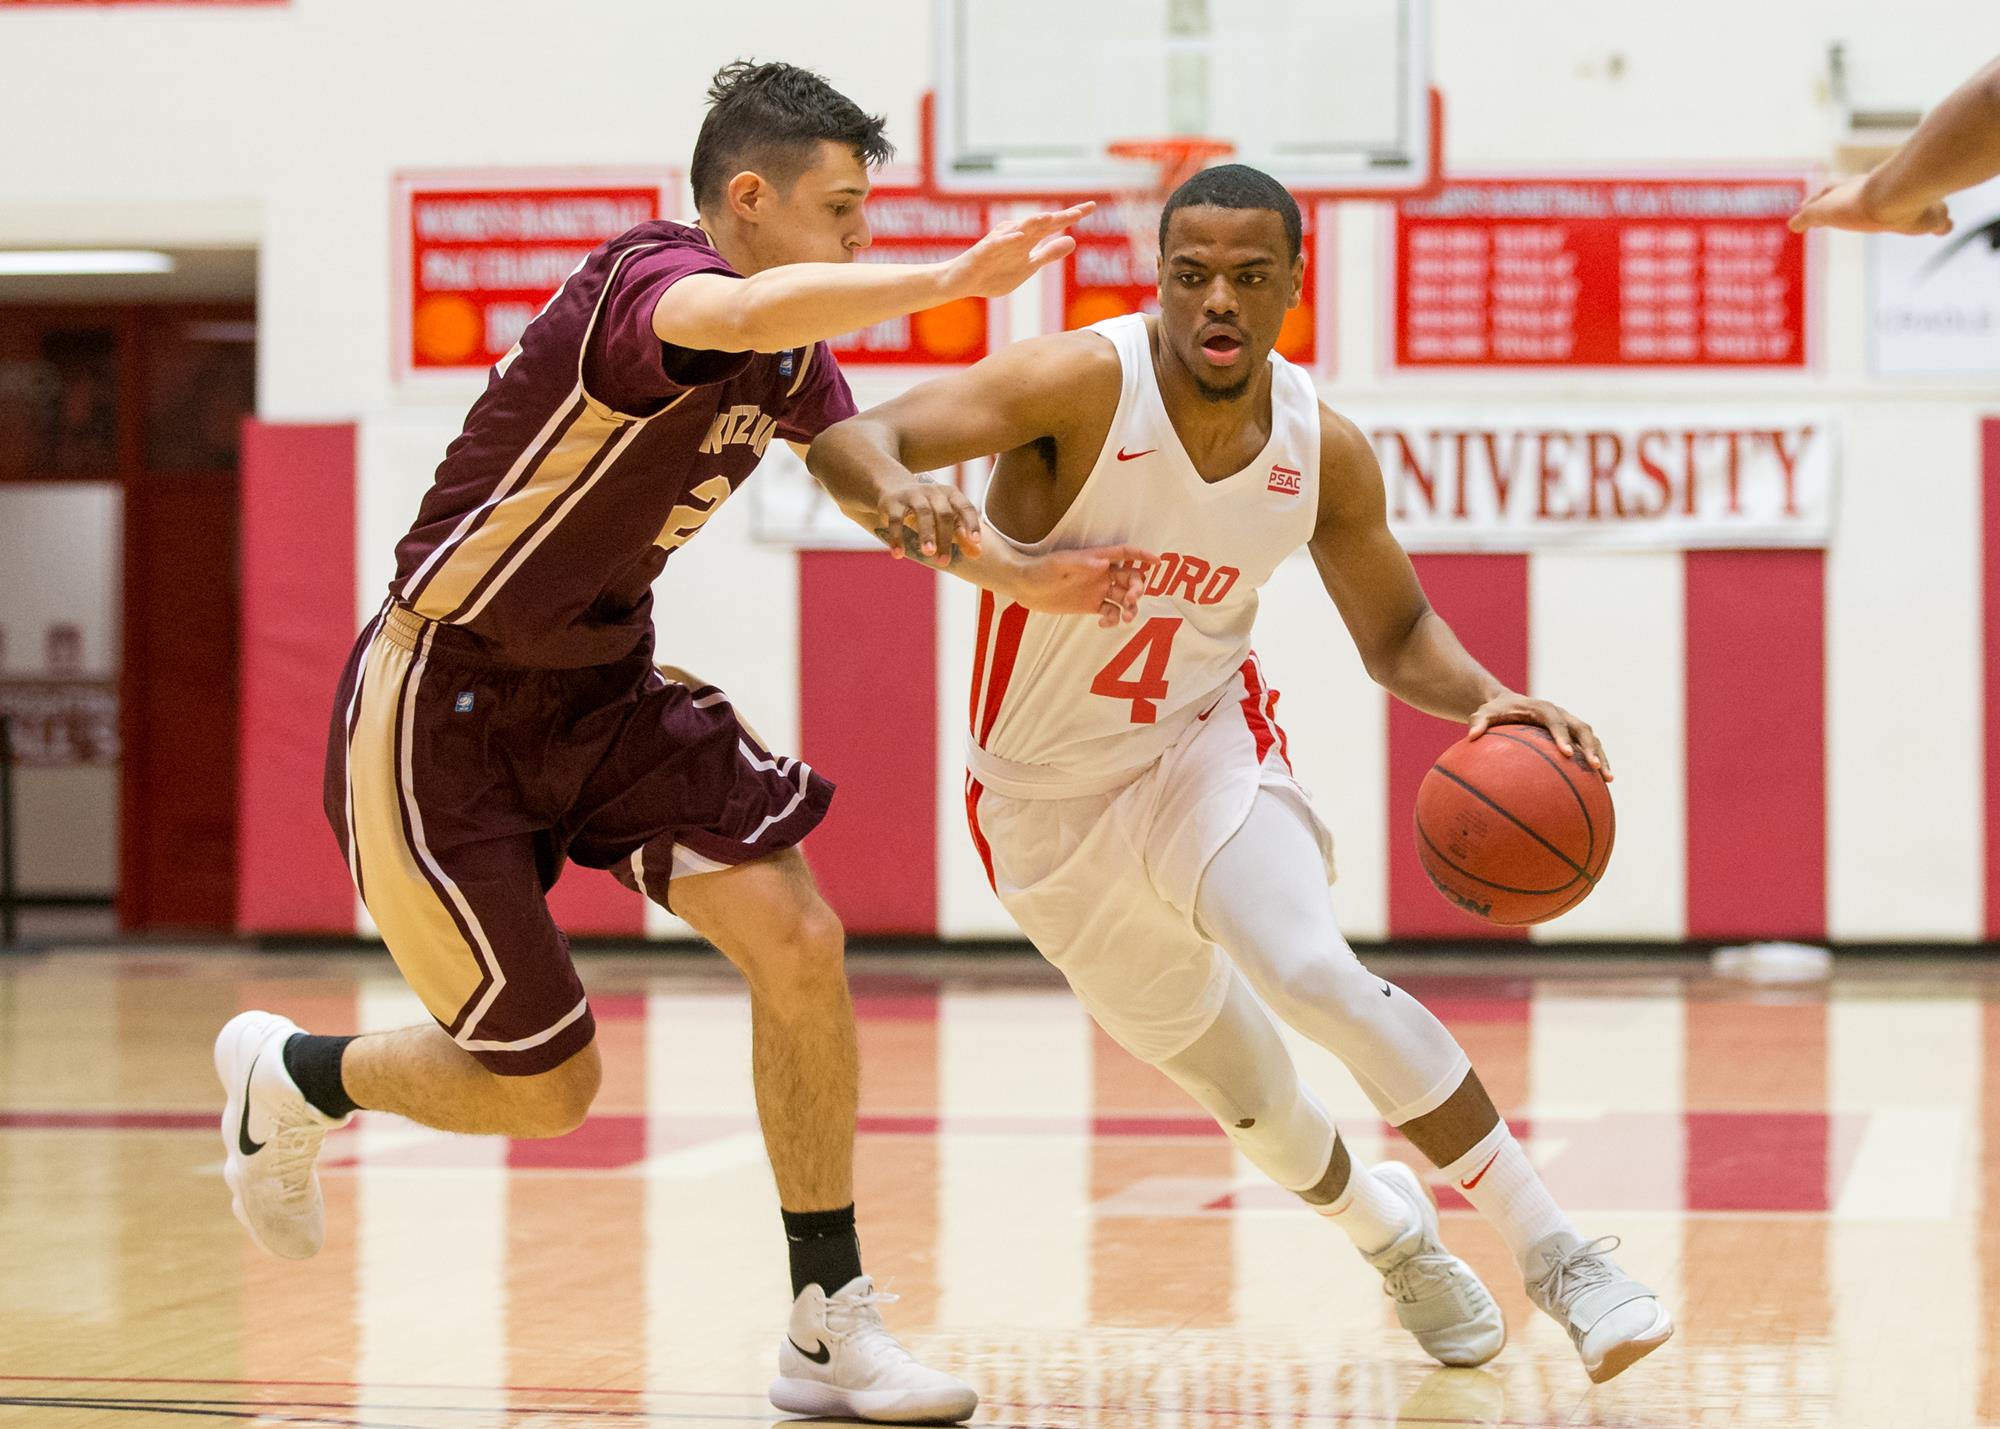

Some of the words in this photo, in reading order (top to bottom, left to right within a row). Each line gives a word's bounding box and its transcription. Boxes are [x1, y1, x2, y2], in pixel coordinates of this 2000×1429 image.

[1268, 471, 1302, 490] PSAC
[1370, 426, 1816, 522] NIVERSITY
[1090, 616, 1184, 724] 4
